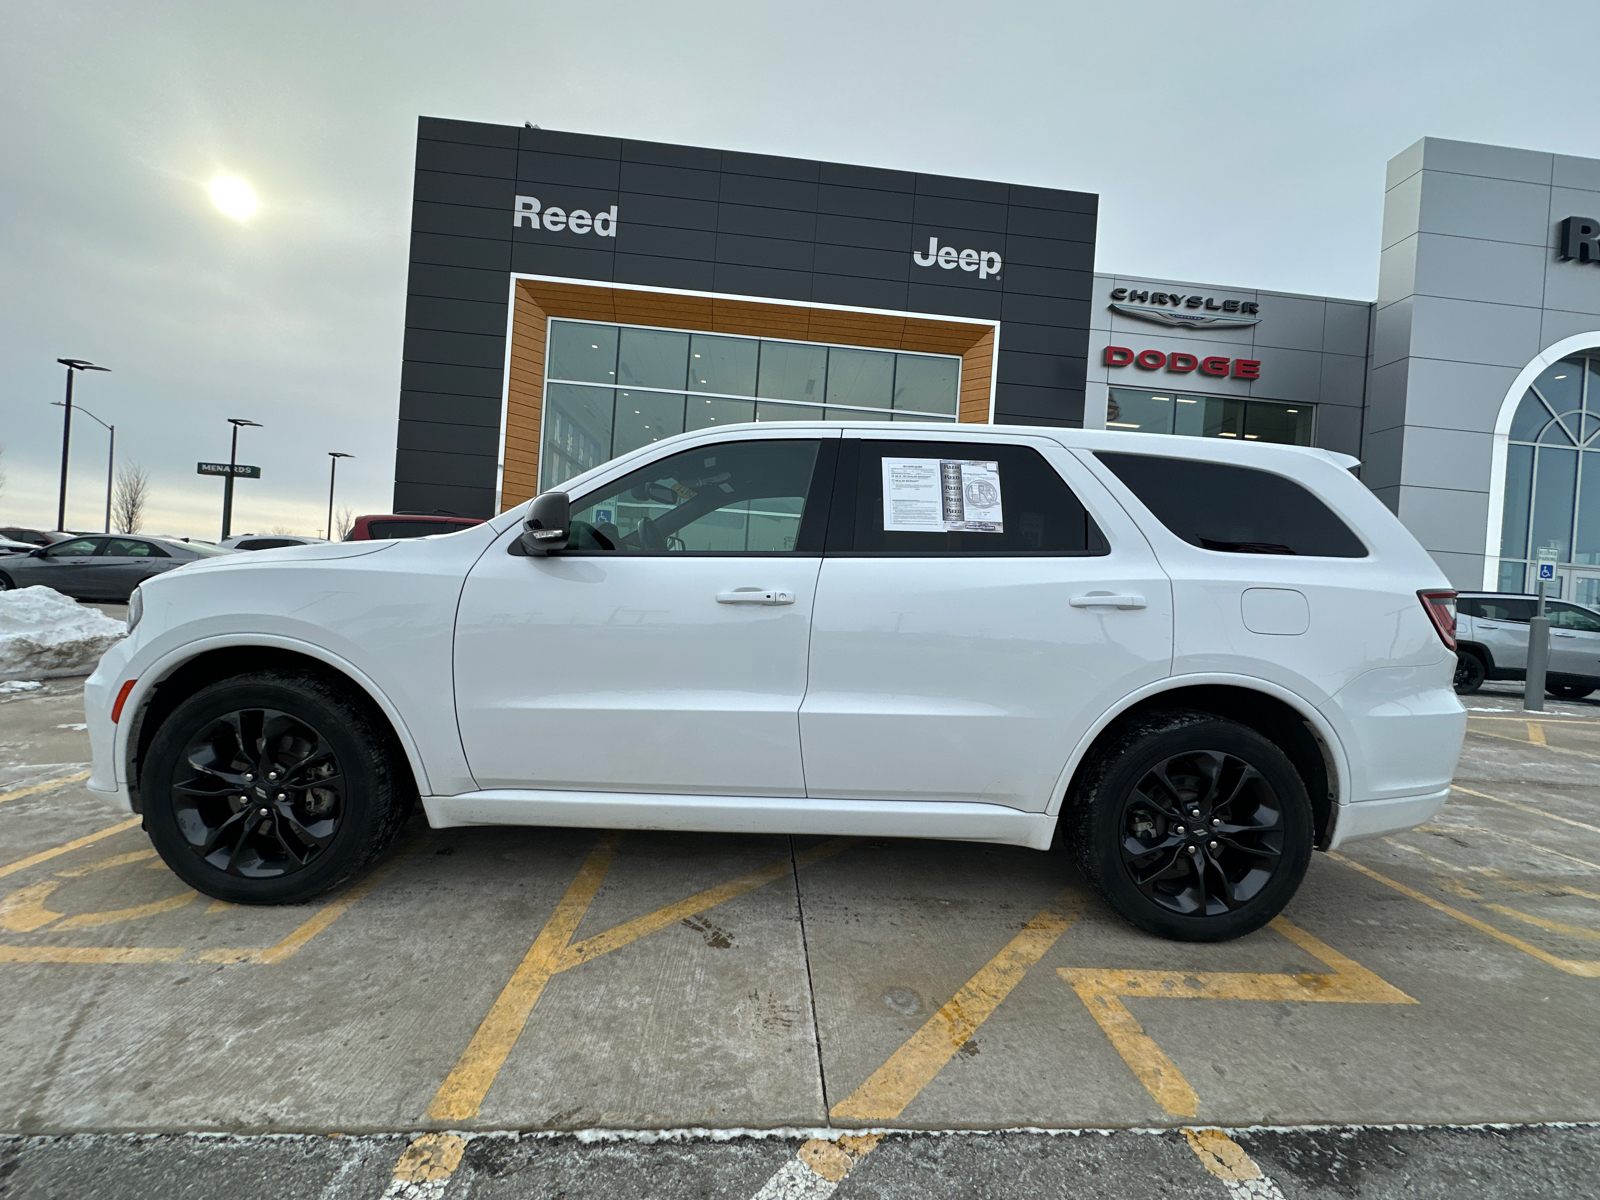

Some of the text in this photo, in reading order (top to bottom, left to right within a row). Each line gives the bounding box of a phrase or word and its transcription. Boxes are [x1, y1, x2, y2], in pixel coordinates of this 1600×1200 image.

[513, 194, 618, 238] Reed
[913, 236, 1002, 280] Jeep
[1110, 288, 1260, 314] CHRYSLER
[1103, 345, 1261, 380] DODGE
